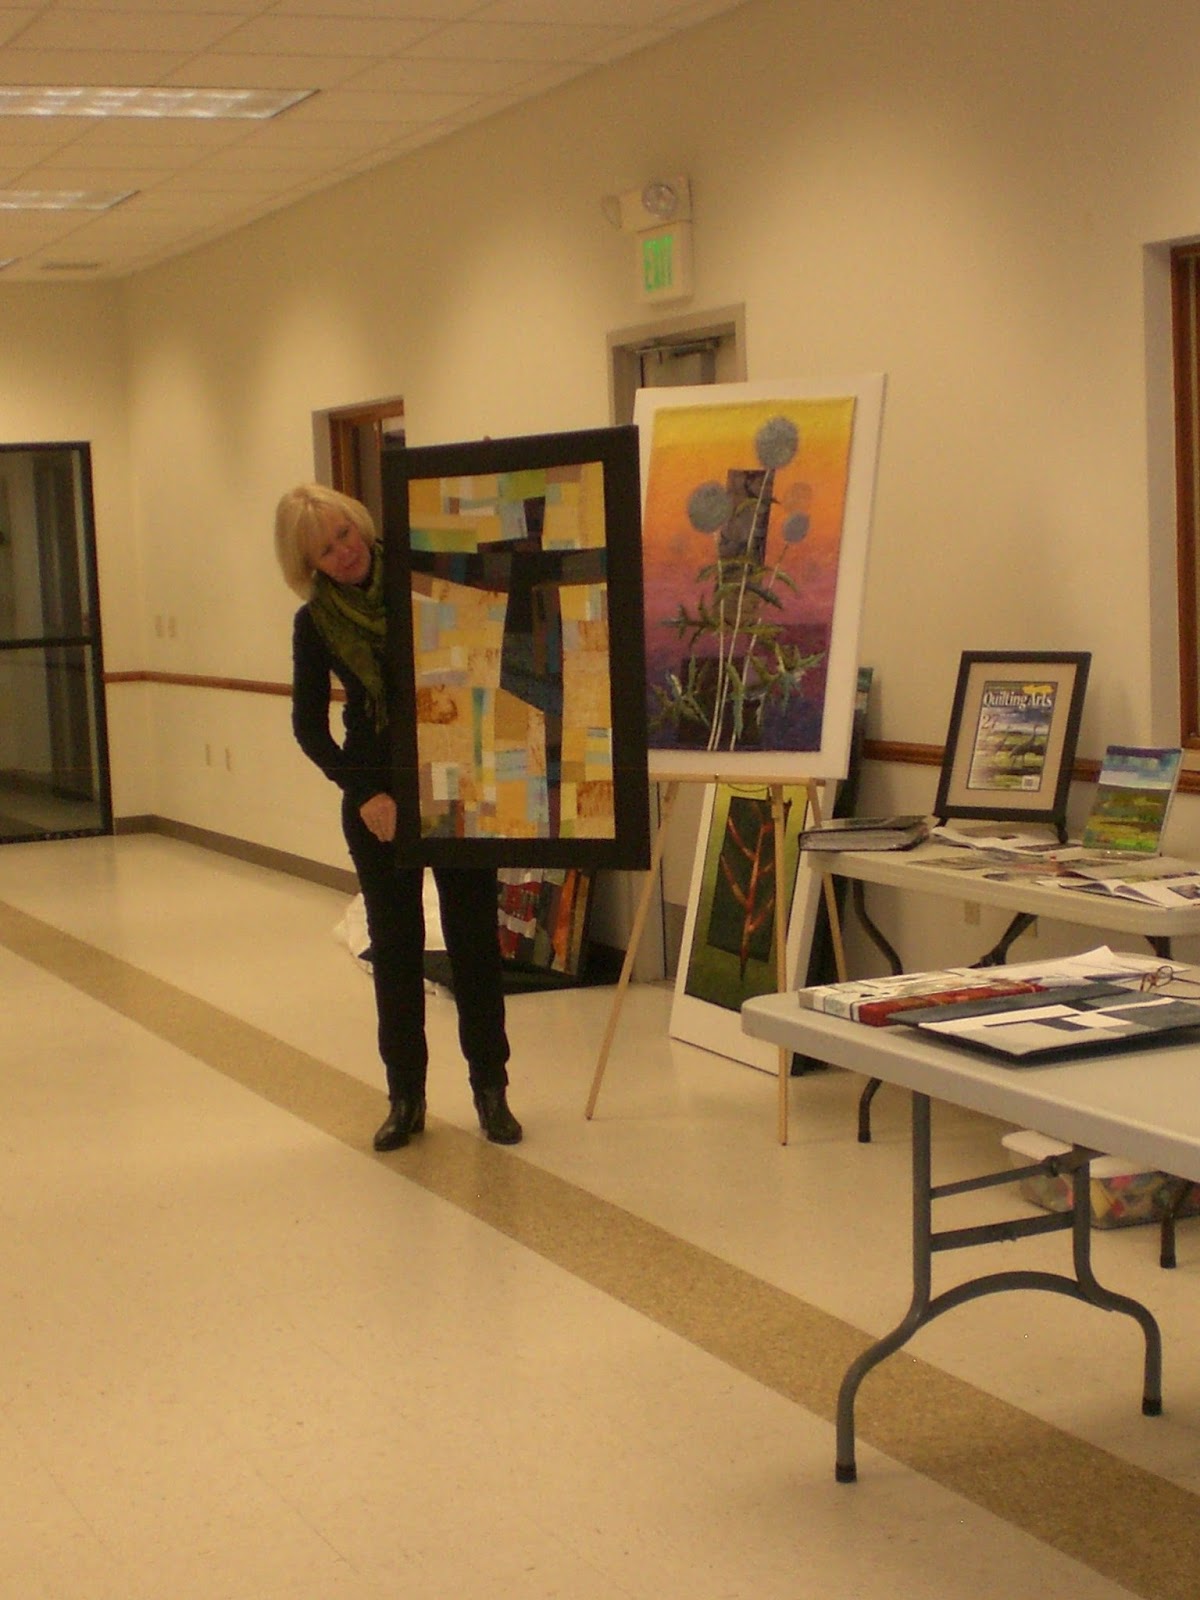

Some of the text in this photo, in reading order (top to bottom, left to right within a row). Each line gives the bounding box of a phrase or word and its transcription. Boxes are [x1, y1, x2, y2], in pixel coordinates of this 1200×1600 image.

[643, 234, 673, 292] EXIT
[983, 690, 1053, 710] Quilting Arts
